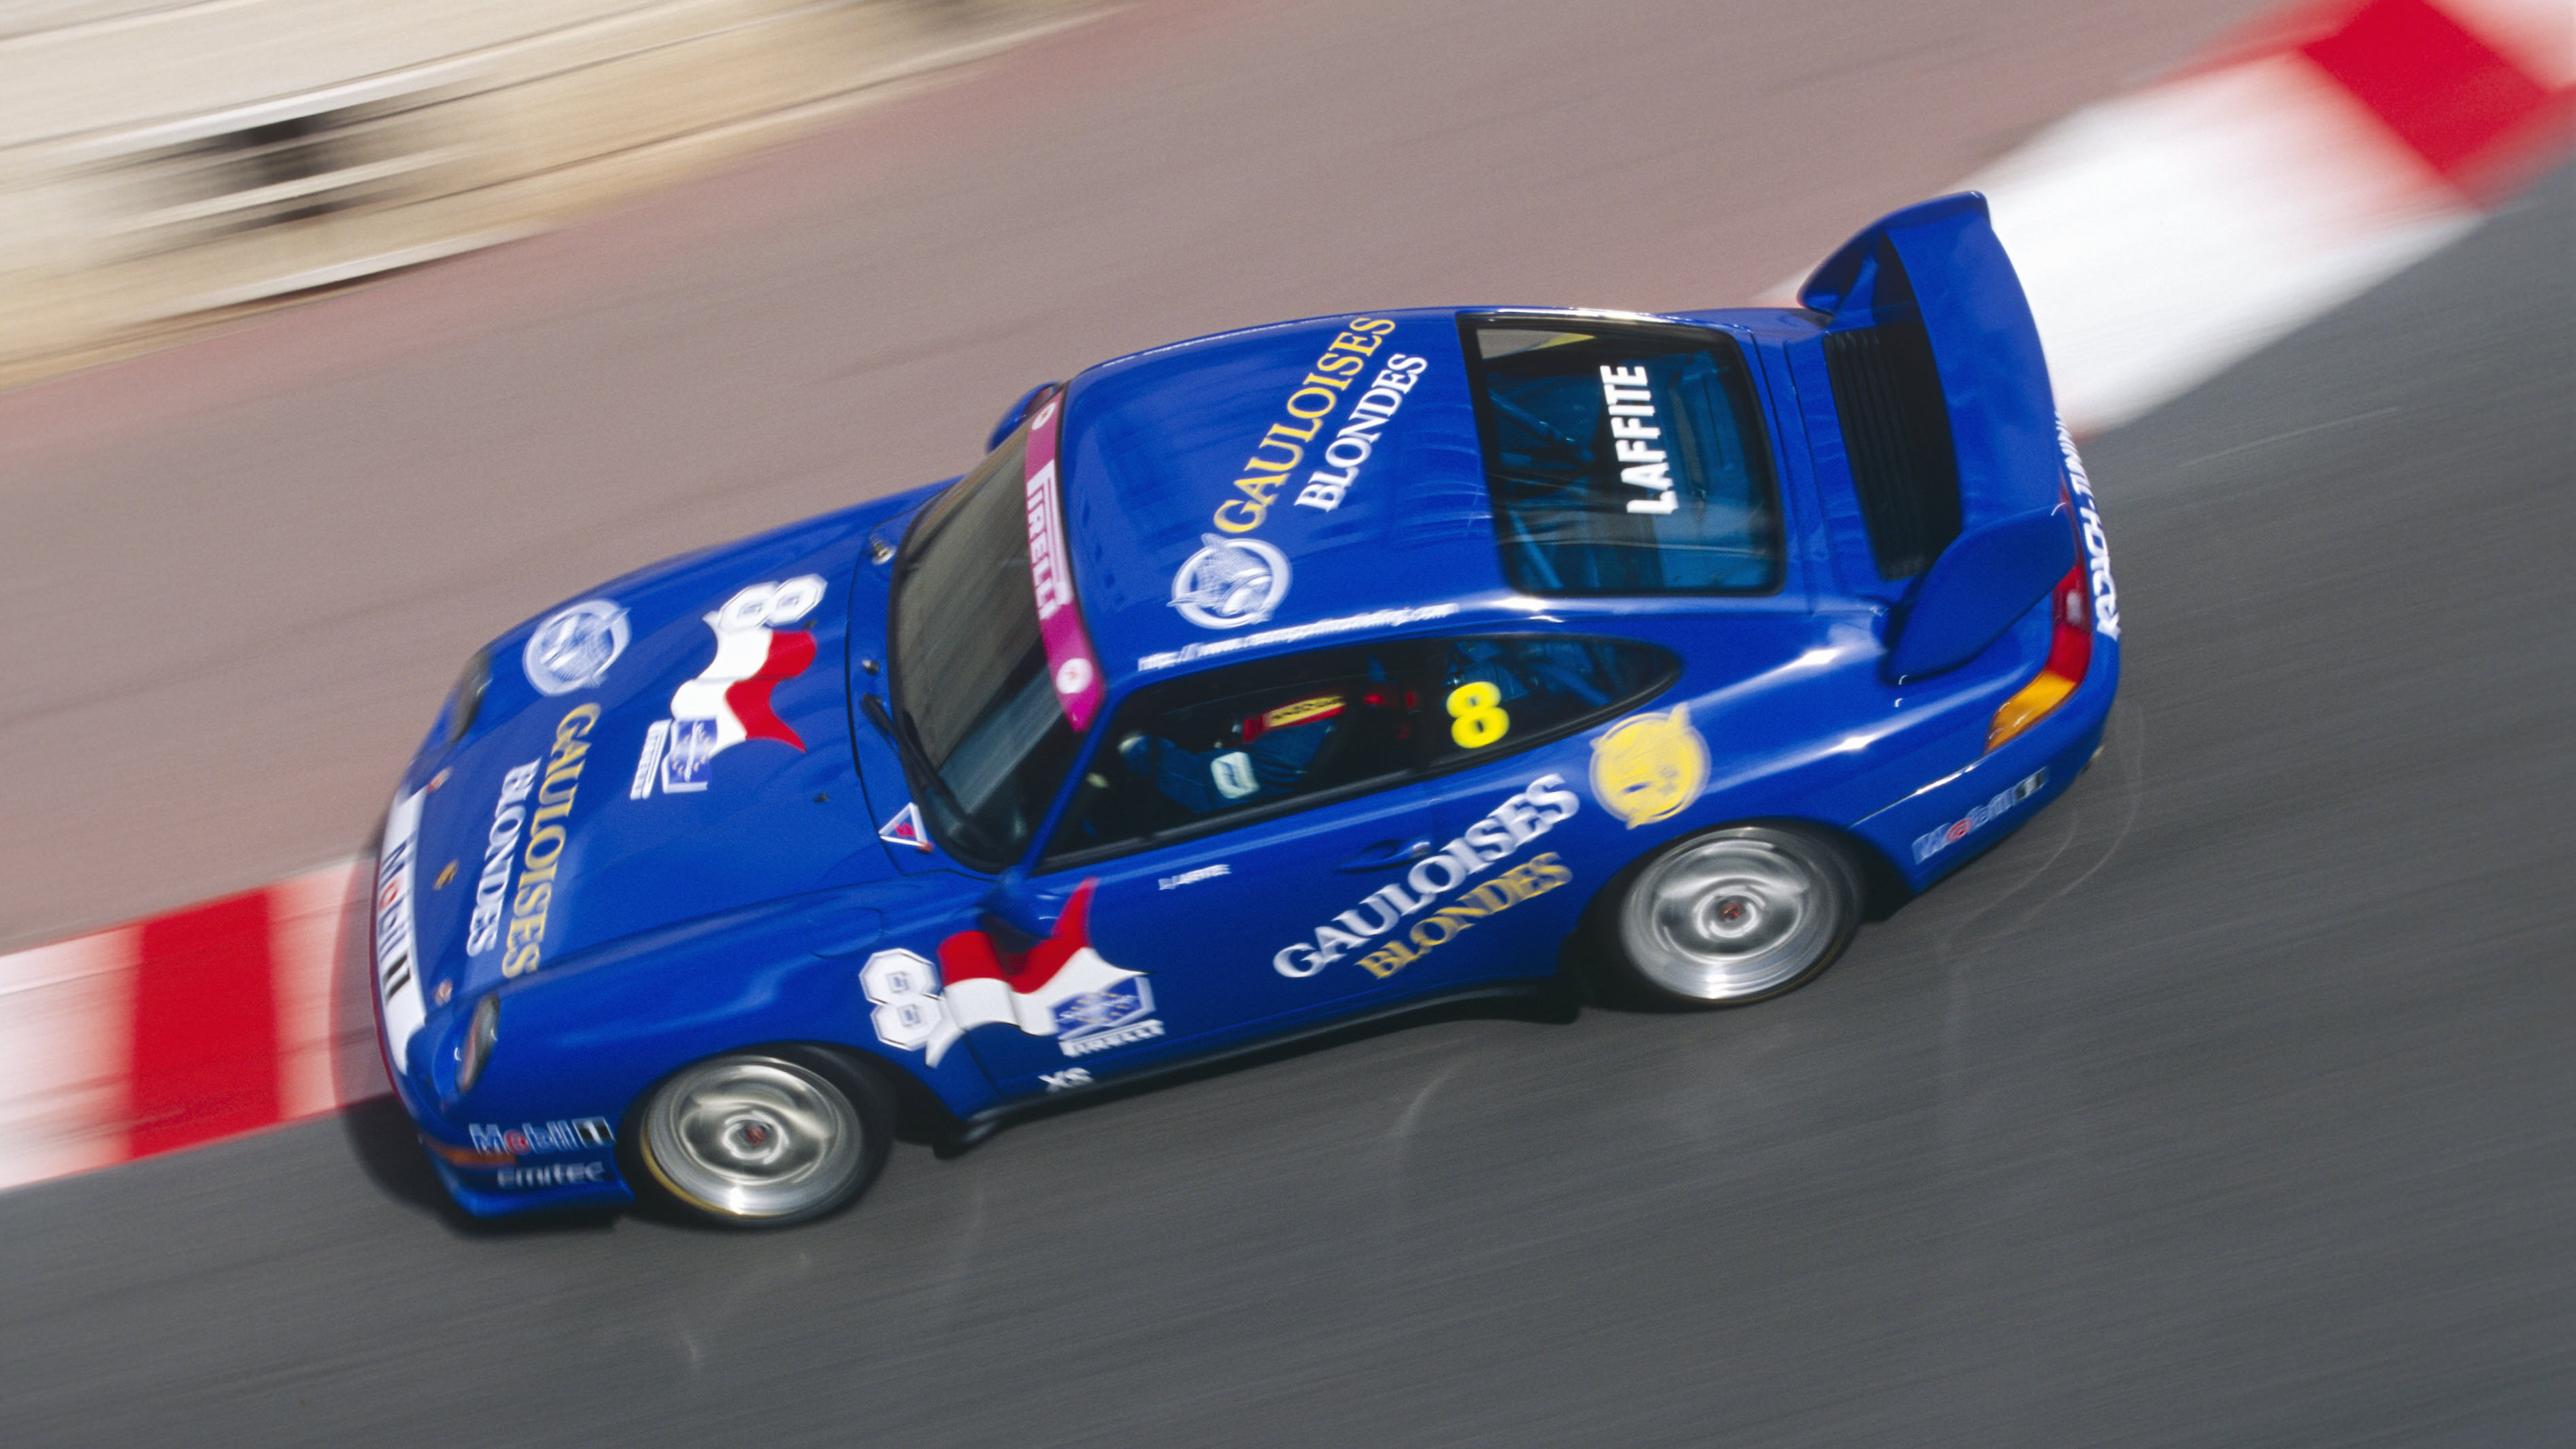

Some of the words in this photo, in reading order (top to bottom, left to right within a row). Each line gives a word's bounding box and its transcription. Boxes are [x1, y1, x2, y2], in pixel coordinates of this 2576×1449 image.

[1214, 318, 1396, 533] GAULOISES
[1294, 353, 1428, 512] BLONDES
[1599, 365, 1678, 514] LAFFITE
[1026, 459, 1075, 620] PIRELLI
[1446, 681, 1510, 749] 8
[467, 756, 542, 956] BLONDES
[502, 703, 601, 978] GAULOISES
[1273, 773, 1580, 978] GAULOISES
[1353, 851, 1573, 980] BLONDES
[859, 948, 947, 1051] 8
[469, 1122, 581, 1155] Mobil
